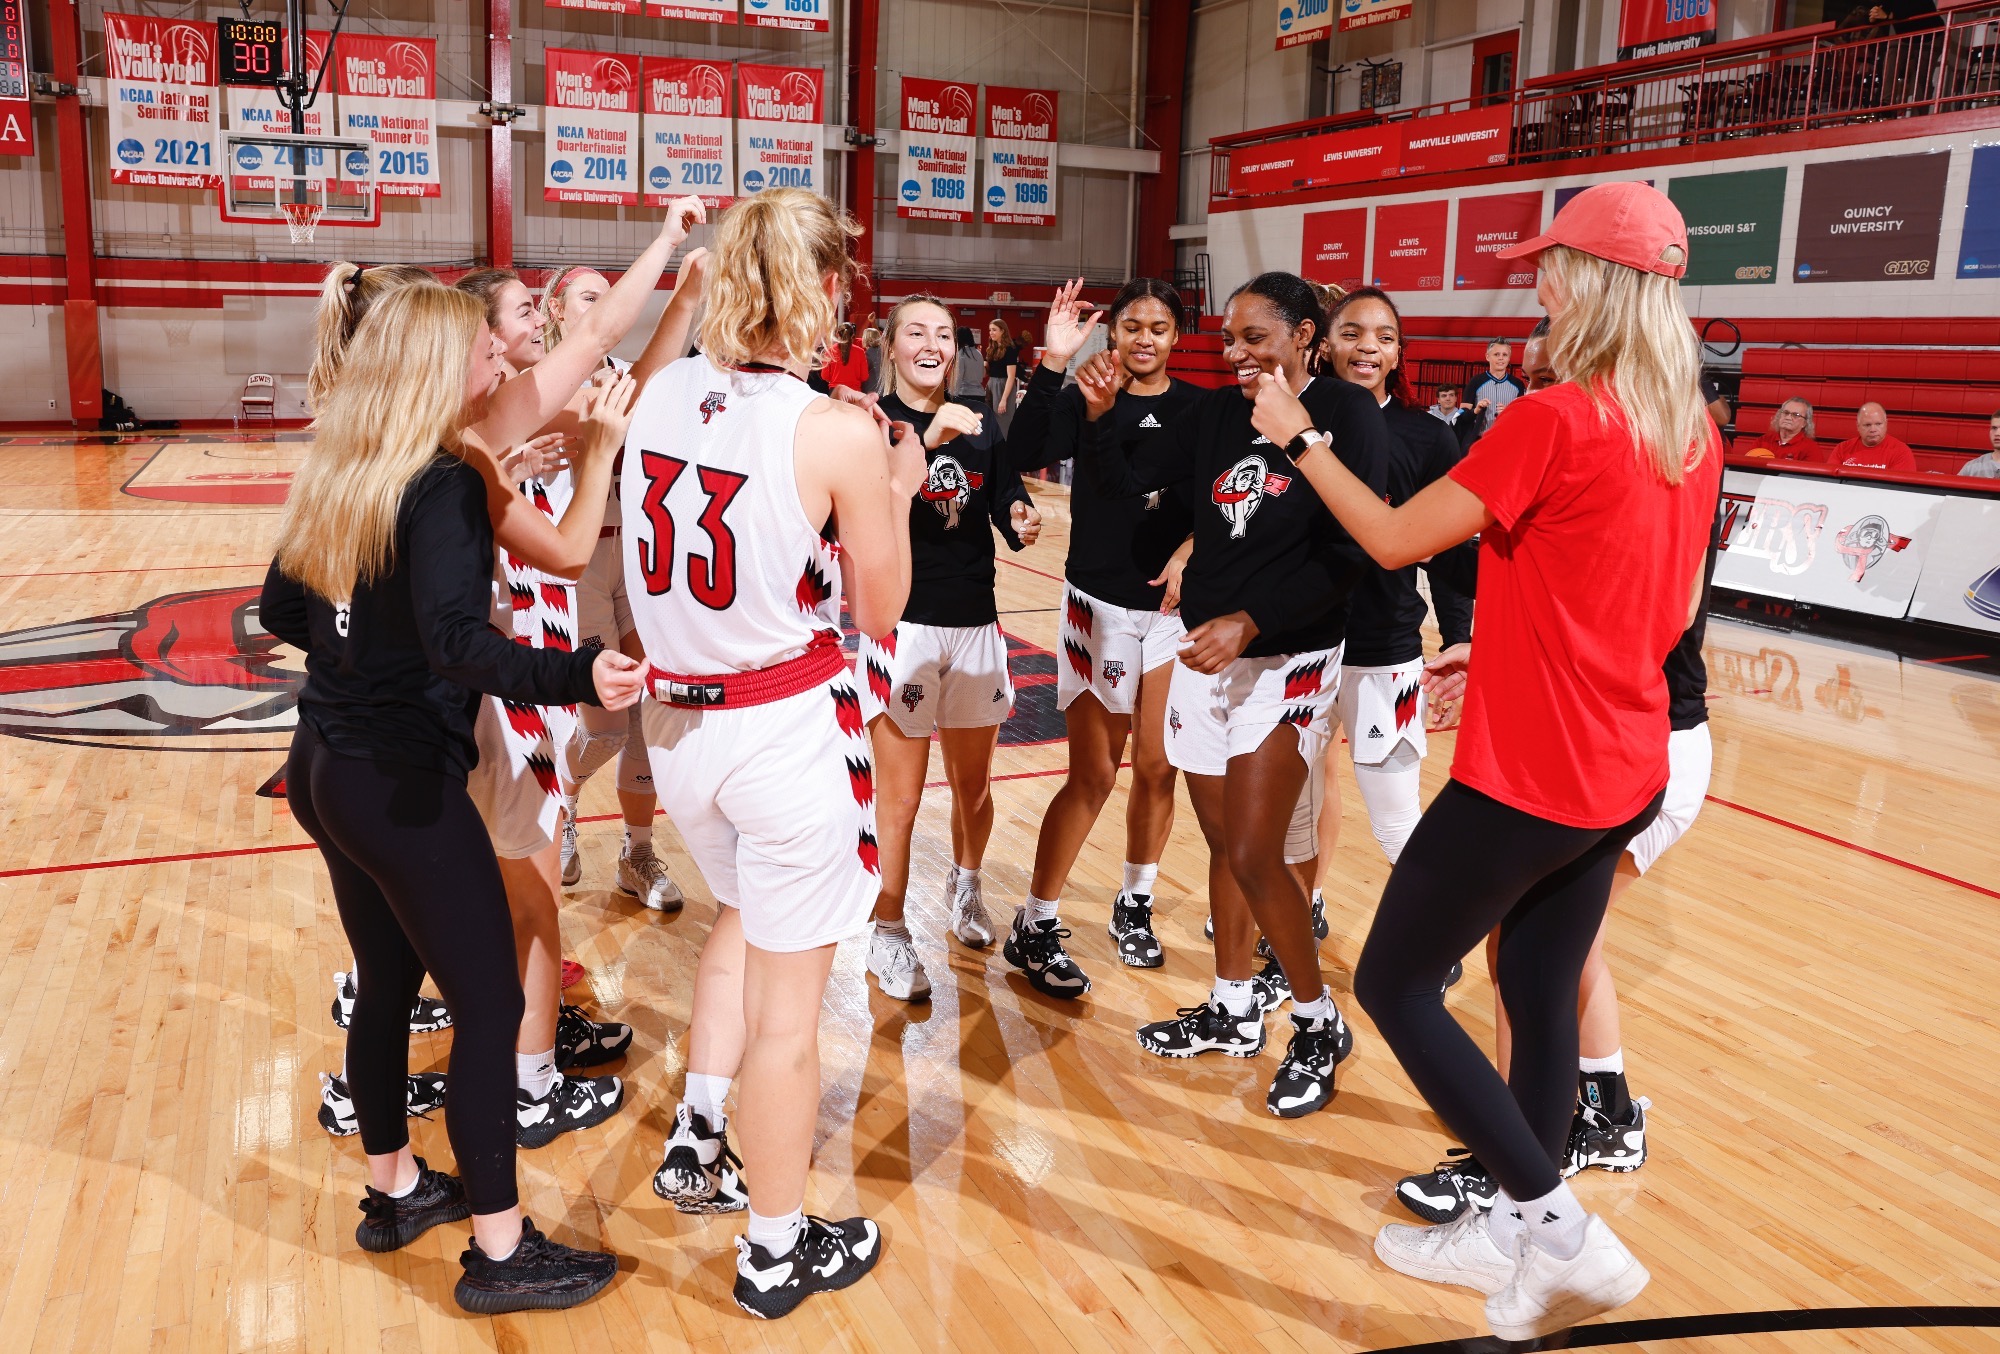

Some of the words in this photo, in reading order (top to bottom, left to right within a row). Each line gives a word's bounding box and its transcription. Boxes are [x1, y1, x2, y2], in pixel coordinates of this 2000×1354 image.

[585, 0, 626, 13] University
[661, 7, 684, 18] Lewis
[685, 9, 724, 23] University
[1349, 17, 1367, 28] Lewis
[1368, 8, 1401, 23] University
[757, 16, 778, 26] Lewis
[779, 17, 816, 31] University
[230, 24, 276, 43] 10:00
[1283, 35, 1297, 47] Lewis
[1298, 29, 1323, 43] University
[118, 38, 162, 58] Men's
[1632, 44, 1656, 60] Lewis
[1657, 36, 1701, 55] University
[233, 42, 270, 74] 30
[346, 57, 386, 75] Men's
[120, 56, 206, 83] Volleyball
[347, 73, 426, 98] Volleyball
[556, 71, 592, 88] Men's
[653, 78, 688, 95] Men's
[120, 88, 154, 104] NCAA
[156, 90, 209, 108] National
[556, 86, 628, 110] Volleyball
[747, 84, 781, 101] Men's
[653, 93, 723, 116] Volleyball
[747, 98, 814, 122] Volleyball
[908, 97, 939, 114] Men's
[138, 104, 210, 123] Semifinalist
[242, 108, 273, 122] NCAA
[276, 110, 320, 124] Nanal
[992, 105, 1022, 121] Men's
[263, 124, 322, 135] Semiflist
[348, 115, 379, 128] NCAA
[381, 116, 429, 131] National
[908, 111, 968, 134] Volleyball
[992, 119, 1049, 140] Volleyball
[371, 130, 412, 144] Runner
[415, 132, 429, 145] Up
[557, 126, 584, 139] NCAA
[587, 128, 627, 142] National
[655, 132, 681, 145] NCAA
[684, 133, 723, 147] National
[1409, 135, 1450, 149] MARYVILLE
[1451, 128, 1499, 144] UNIVERSITY
[120, 150, 145, 159] NCAA
[154, 138, 211, 166] 2021
[557, 140, 627, 155] Quarterfinalist
[750, 136, 774, 149] NCAA
[776, 138, 813, 152] National
[239, 156, 263, 165] NCAA
[667, 146, 723, 160] Semifinalist
[760, 151, 813, 165] Semifinalist
[909, 145, 932, 159] NCAA
[933, 148, 967, 162] National
[993, 152, 1015, 165] NCAA
[1017, 154, 1049, 167] National
[1323, 151, 1343, 162] LEWIS
[1343, 146, 1382, 159] UNIVERSITY
[379, 150, 429, 176] 2015
[552, 170, 573, 179] NCAA
[584, 157, 627, 181] 2014
[918, 160, 967, 175] Semifinalist
[1241, 164, 1260, 174] DRURY
[1261, 159, 1294, 171] UNIVERSITY
[129, 171, 157, 185] Lewis
[158, 173, 204, 189] University
[651, 176, 671, 184] NCAA
[681, 162, 723, 185] 2012
[769, 167, 813, 188] 2004
[1002, 166, 1048, 180] Semifinalist
[248, 177, 275, 189] Lewis
[279, 179, 320, 192] nivsity
[356, 183, 380, 196] Lew
[382, 184, 425, 197] University
[931, 177, 965, 200] 1998
[559, 190, 582, 202] Lewis
[584, 192, 623, 205] University
[1015, 183, 1048, 204] 1996
[908, 208, 928, 218] Lewis
[929, 209, 961, 222] University
[994, 213, 1012, 224] Lewis
[1013, 214, 1044, 226] University
[1844, 206, 1893, 219] QUINCY
[1687, 224, 1734, 236] MISSOURI
[1737, 223, 1756, 233] S&T
[1830, 220, 1904, 235] UNIVERSITY
[1399, 238, 1419, 247] LEWIS
[1477, 231, 1518, 242] MARYVILLE
[1323, 243, 1342, 251] DRURY
[1390, 248, 1427, 258] UNIVERSITY
[1316, 252, 1349, 261] UNIVERSITY
[1735, 266, 1772, 279] GLVC
[1884, 260, 1930, 275] GLVC
[1418, 276, 1441, 287] GLVC
[1508, 273, 1534, 285] GLVC
[250, 375, 271, 384] LEWIS
[638, 449, 748, 610] 33
[1719, 493, 1829, 576] YERS
